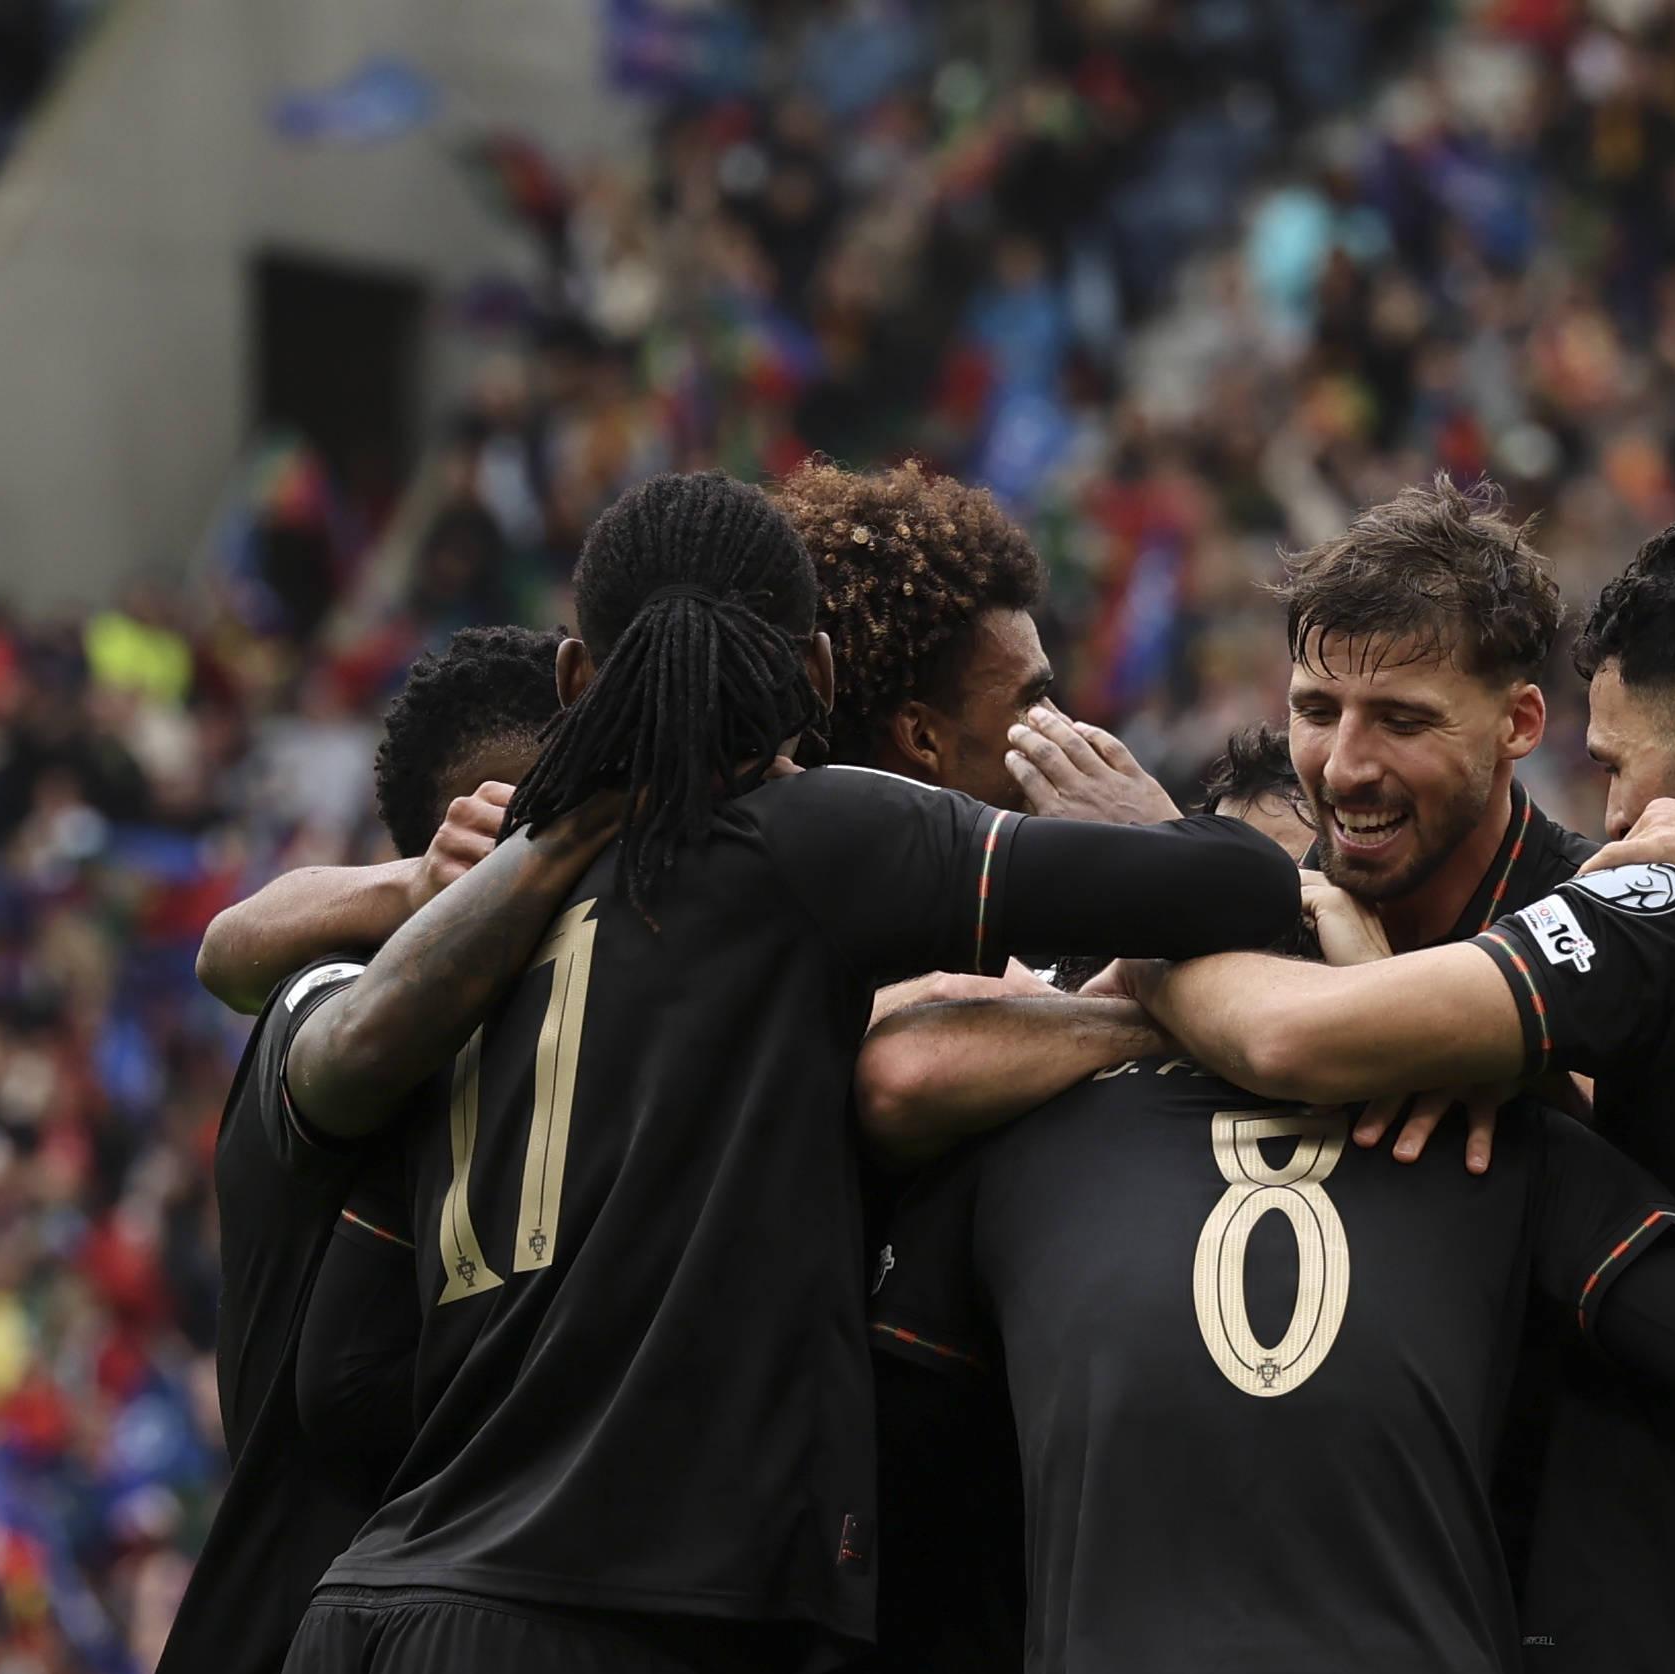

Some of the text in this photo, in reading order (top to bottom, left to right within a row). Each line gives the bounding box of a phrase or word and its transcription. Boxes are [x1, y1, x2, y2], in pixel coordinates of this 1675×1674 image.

[1547, 923, 1578, 955] 10
[438, 897, 599, 1307] 17
[1193, 1110, 1351, 1398] 8
